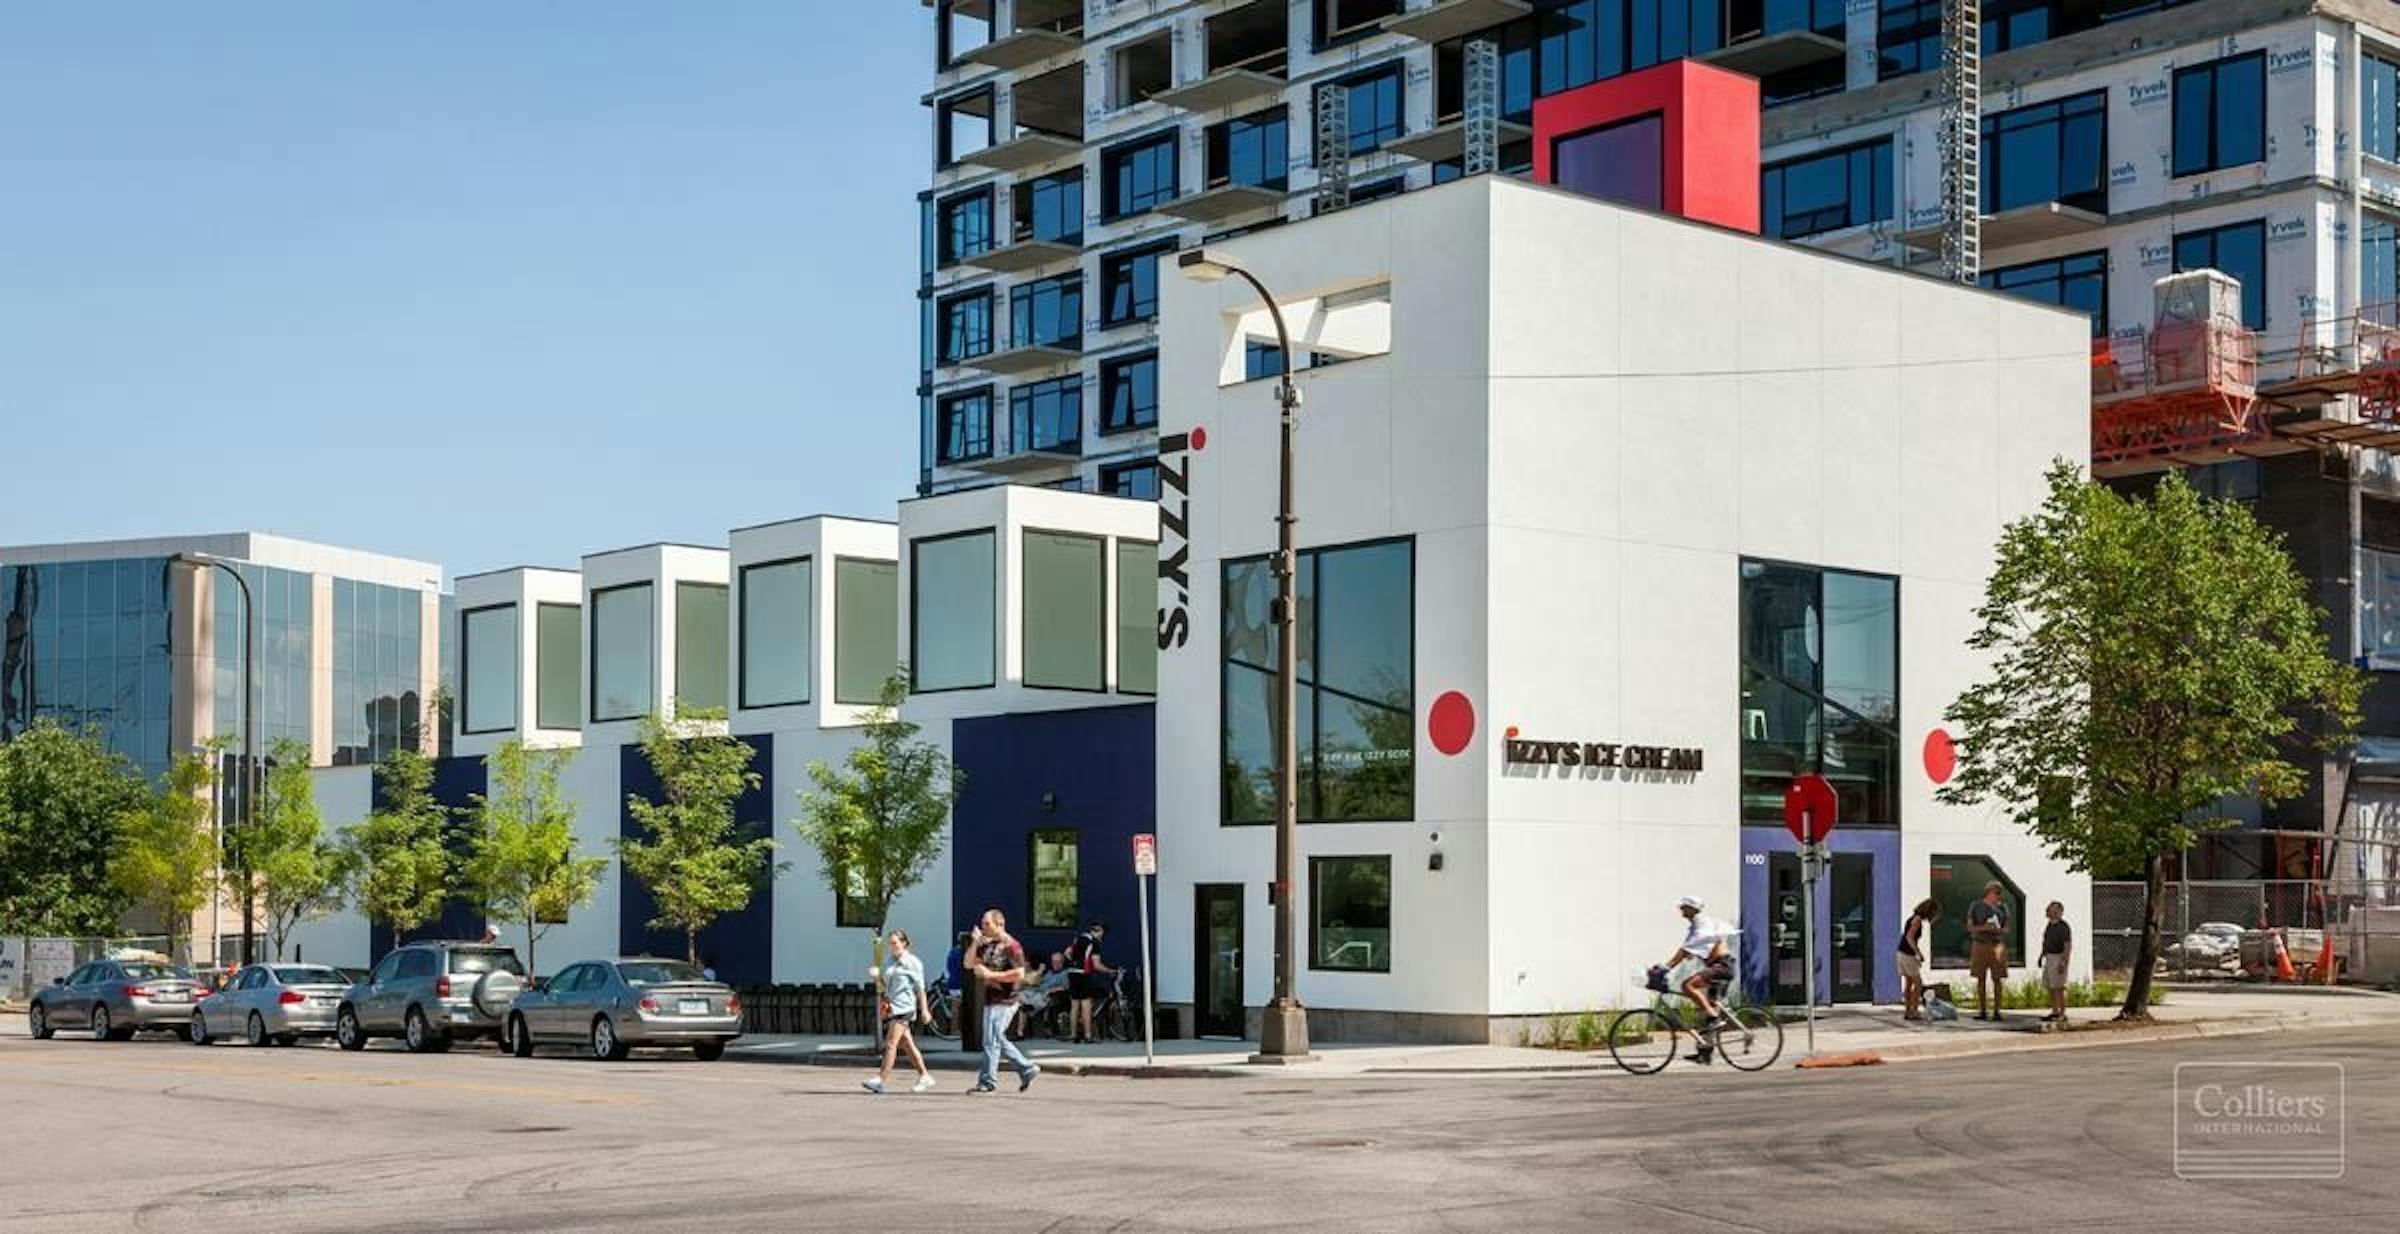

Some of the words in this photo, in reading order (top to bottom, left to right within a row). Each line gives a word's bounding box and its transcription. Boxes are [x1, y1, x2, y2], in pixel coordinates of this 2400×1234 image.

[2128, 80, 2167, 98] Tyvek
[1583, 742, 1622, 768] ICE
[1623, 745, 1703, 772] CREAM
